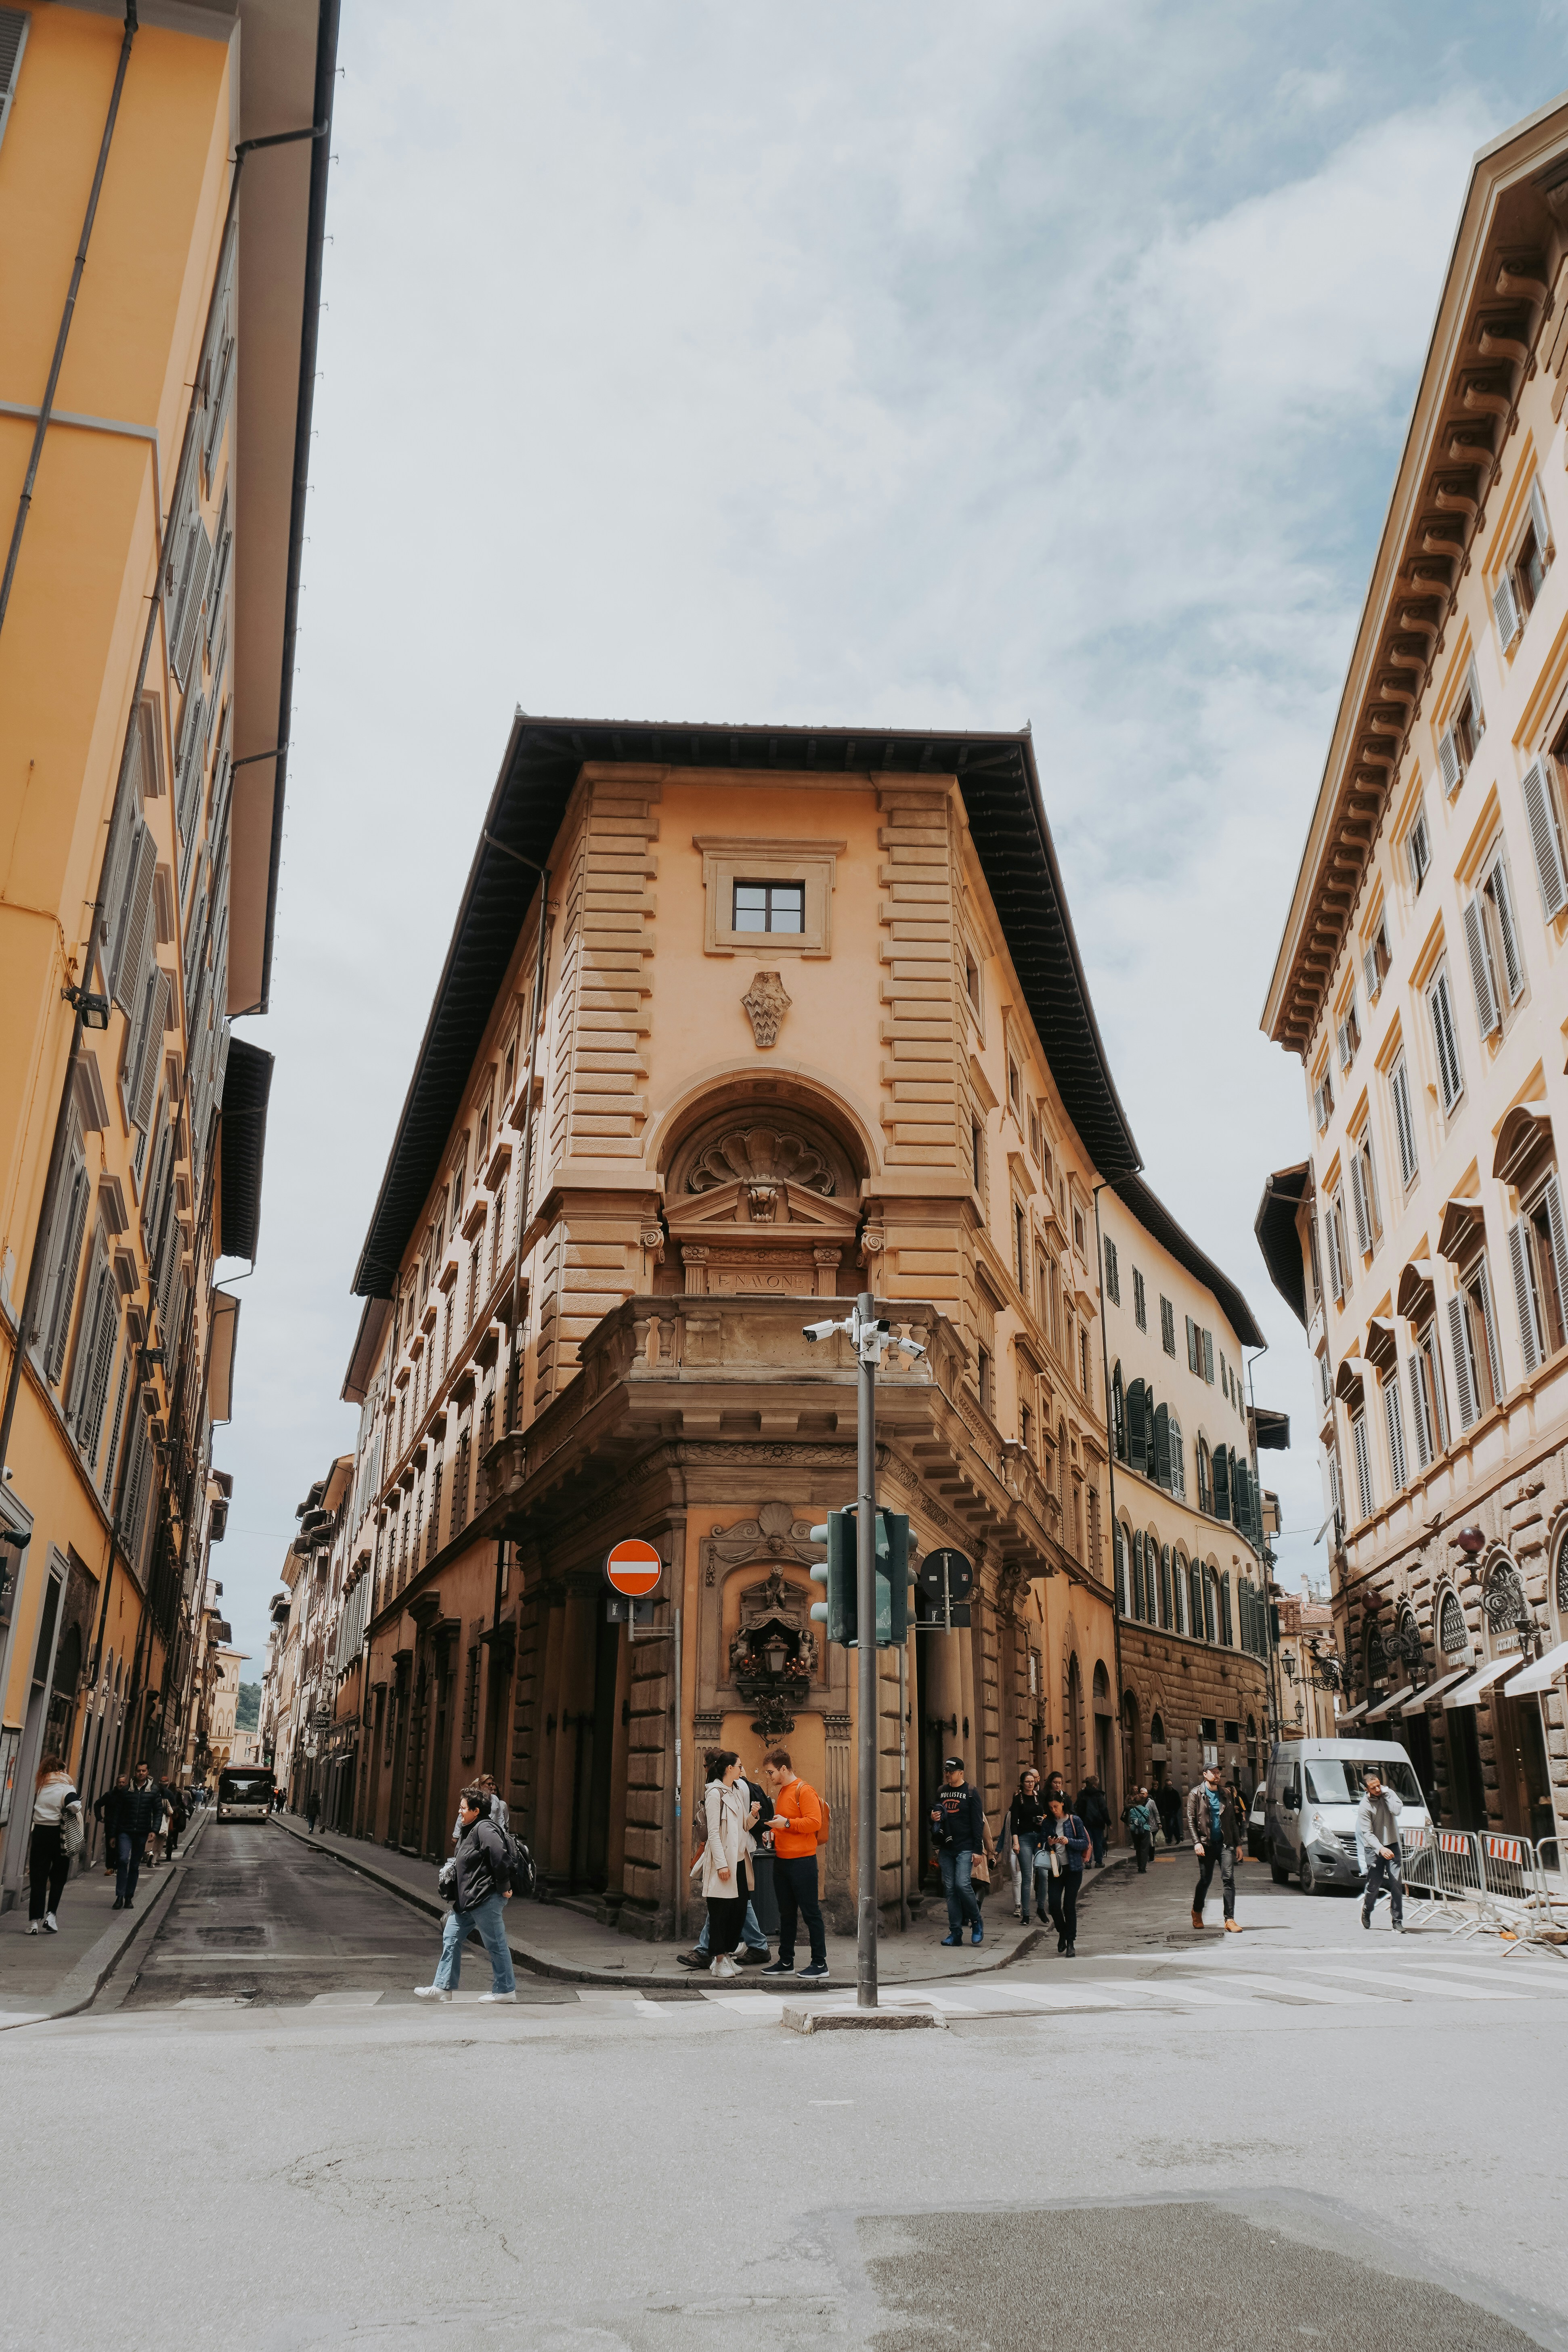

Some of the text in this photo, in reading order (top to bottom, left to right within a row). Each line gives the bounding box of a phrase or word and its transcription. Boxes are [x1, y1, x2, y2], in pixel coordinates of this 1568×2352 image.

[734, 1275, 804, 1289] NAVONE
[319, 1655, 336, 1713] MARIO
[940, 1792, 966, 1800] HOLLISTER
